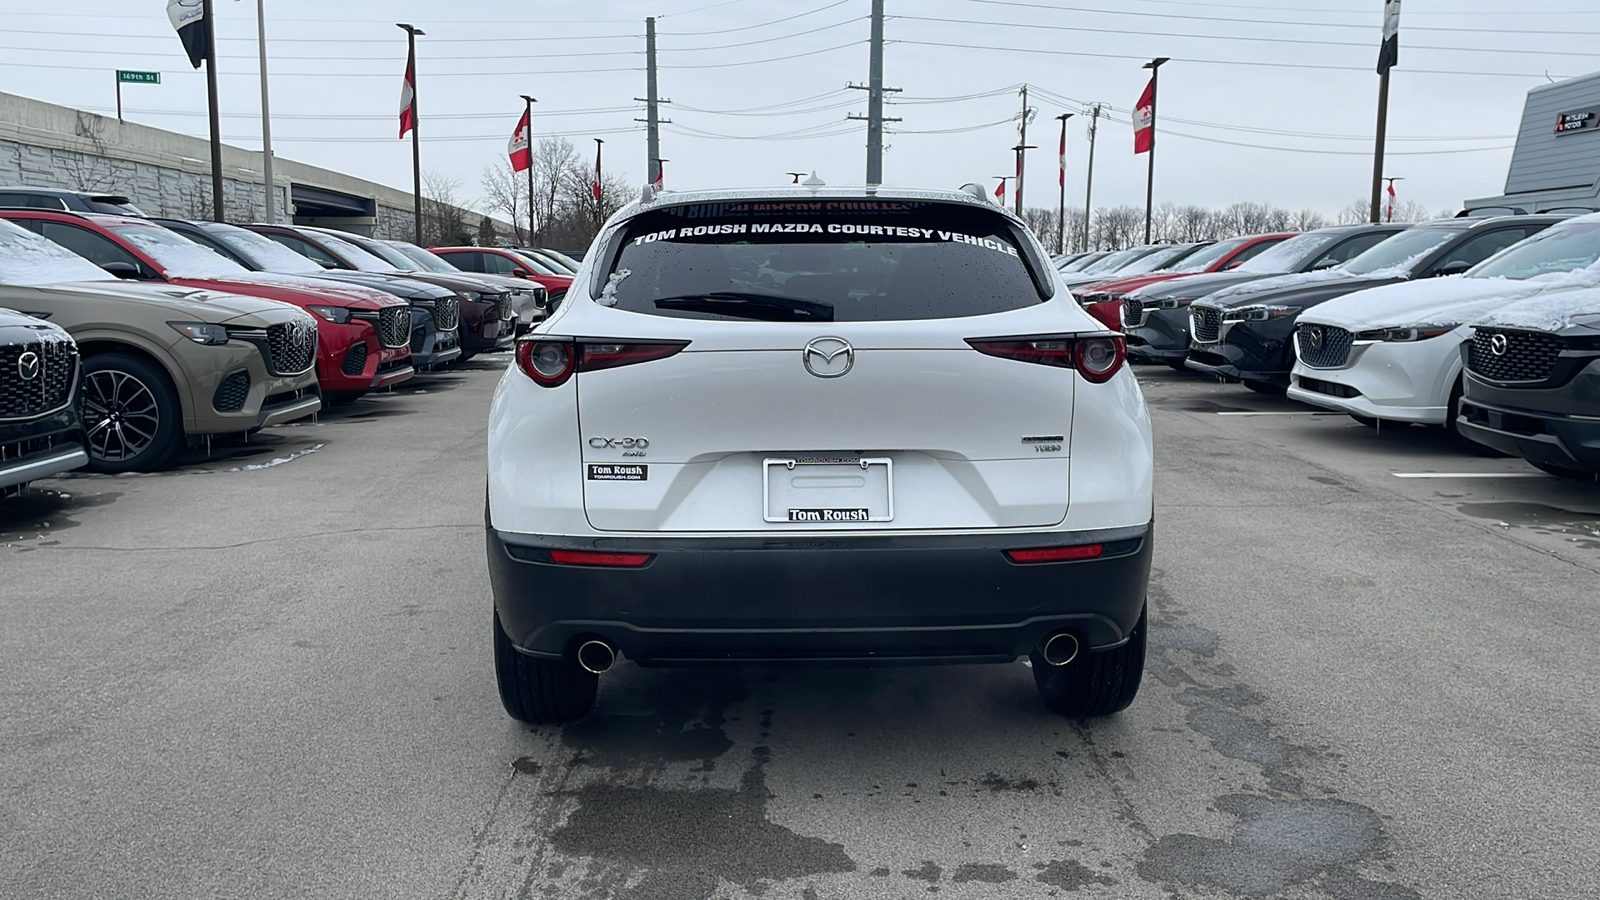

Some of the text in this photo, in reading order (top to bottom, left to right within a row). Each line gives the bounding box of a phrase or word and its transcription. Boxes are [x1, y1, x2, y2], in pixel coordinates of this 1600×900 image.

[634, 223, 1019, 258] TOM ROUSH MAZDA COURTESY VEHICLE
[588, 436, 650, 450] CX-30
[622, 450, 647, 458] AWD
[592, 465, 643, 475] Tom Roush
[789, 508, 868, 521] Tom Roush
